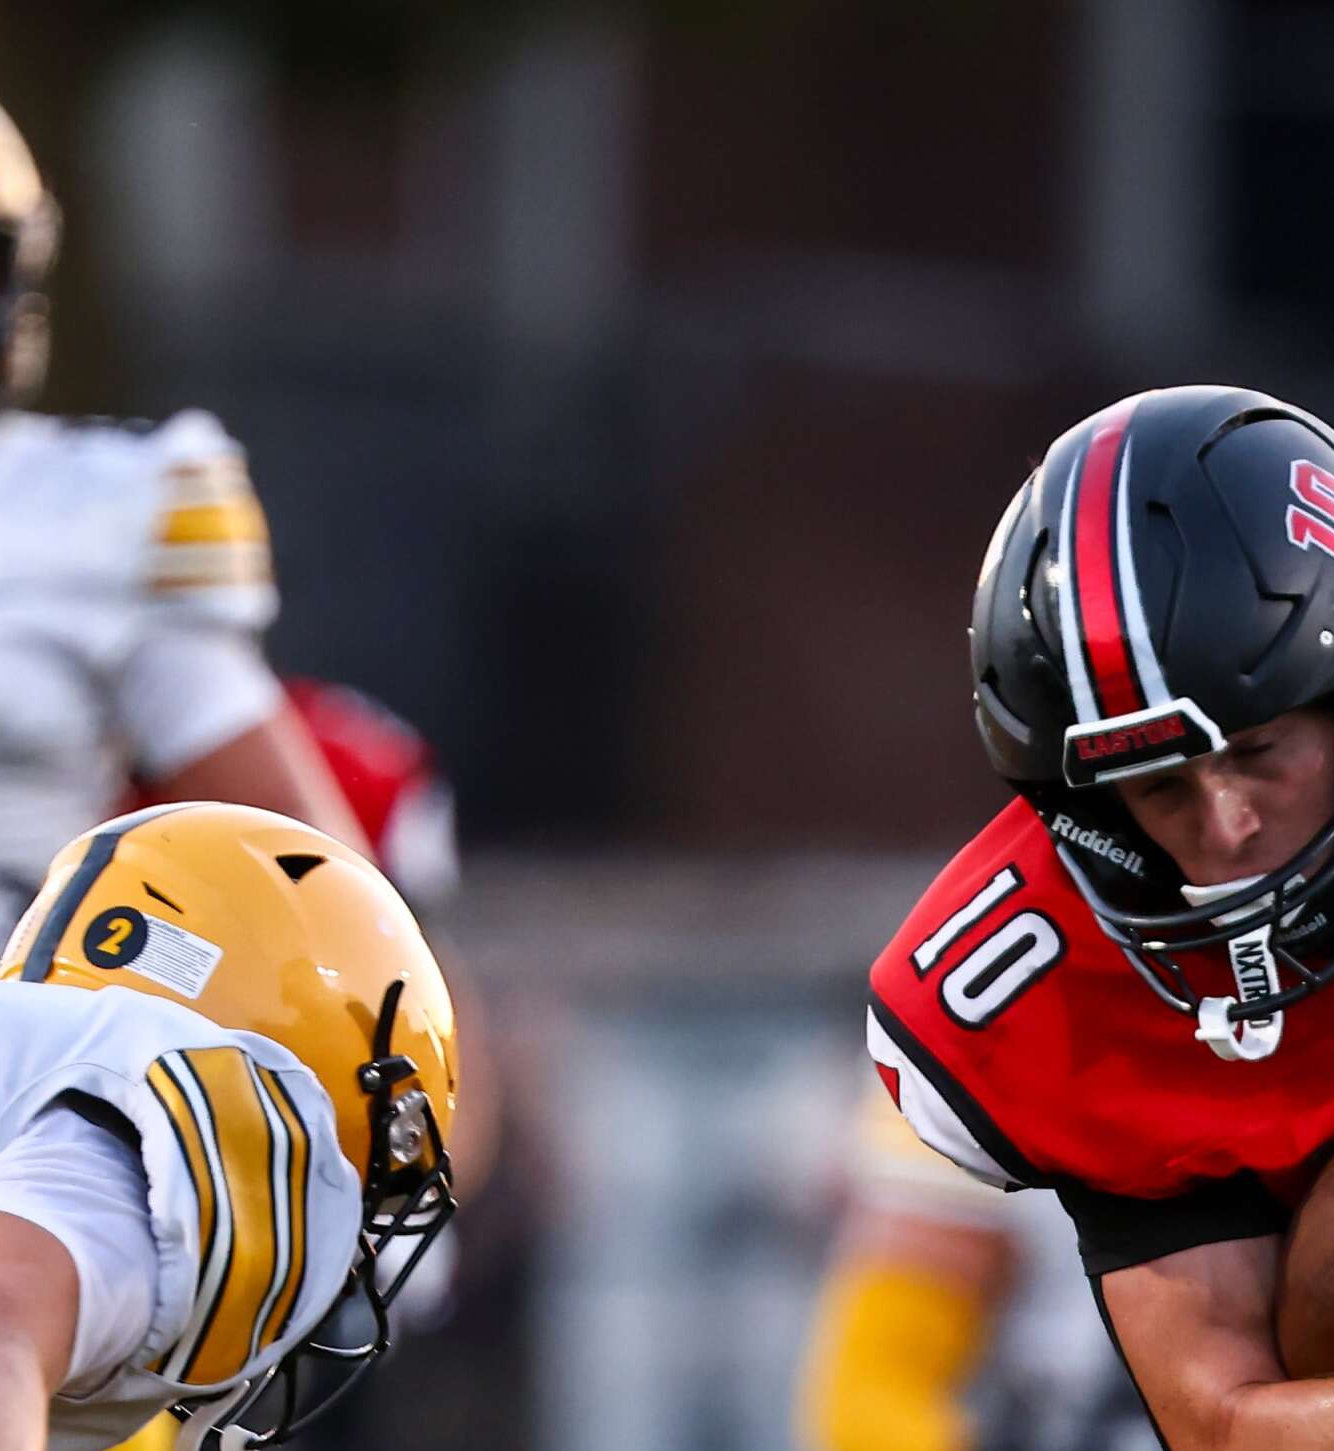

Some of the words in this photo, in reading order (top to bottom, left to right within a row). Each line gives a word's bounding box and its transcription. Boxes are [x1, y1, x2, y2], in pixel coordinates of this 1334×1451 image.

[1076, 715, 1186, 761] EASTON
[1051, 812, 1144, 875] Riddell
[96, 917, 134, 956] 2
[909, 861, 1068, 1032] 10
[1234, 940, 1274, 1030] NXTRD
